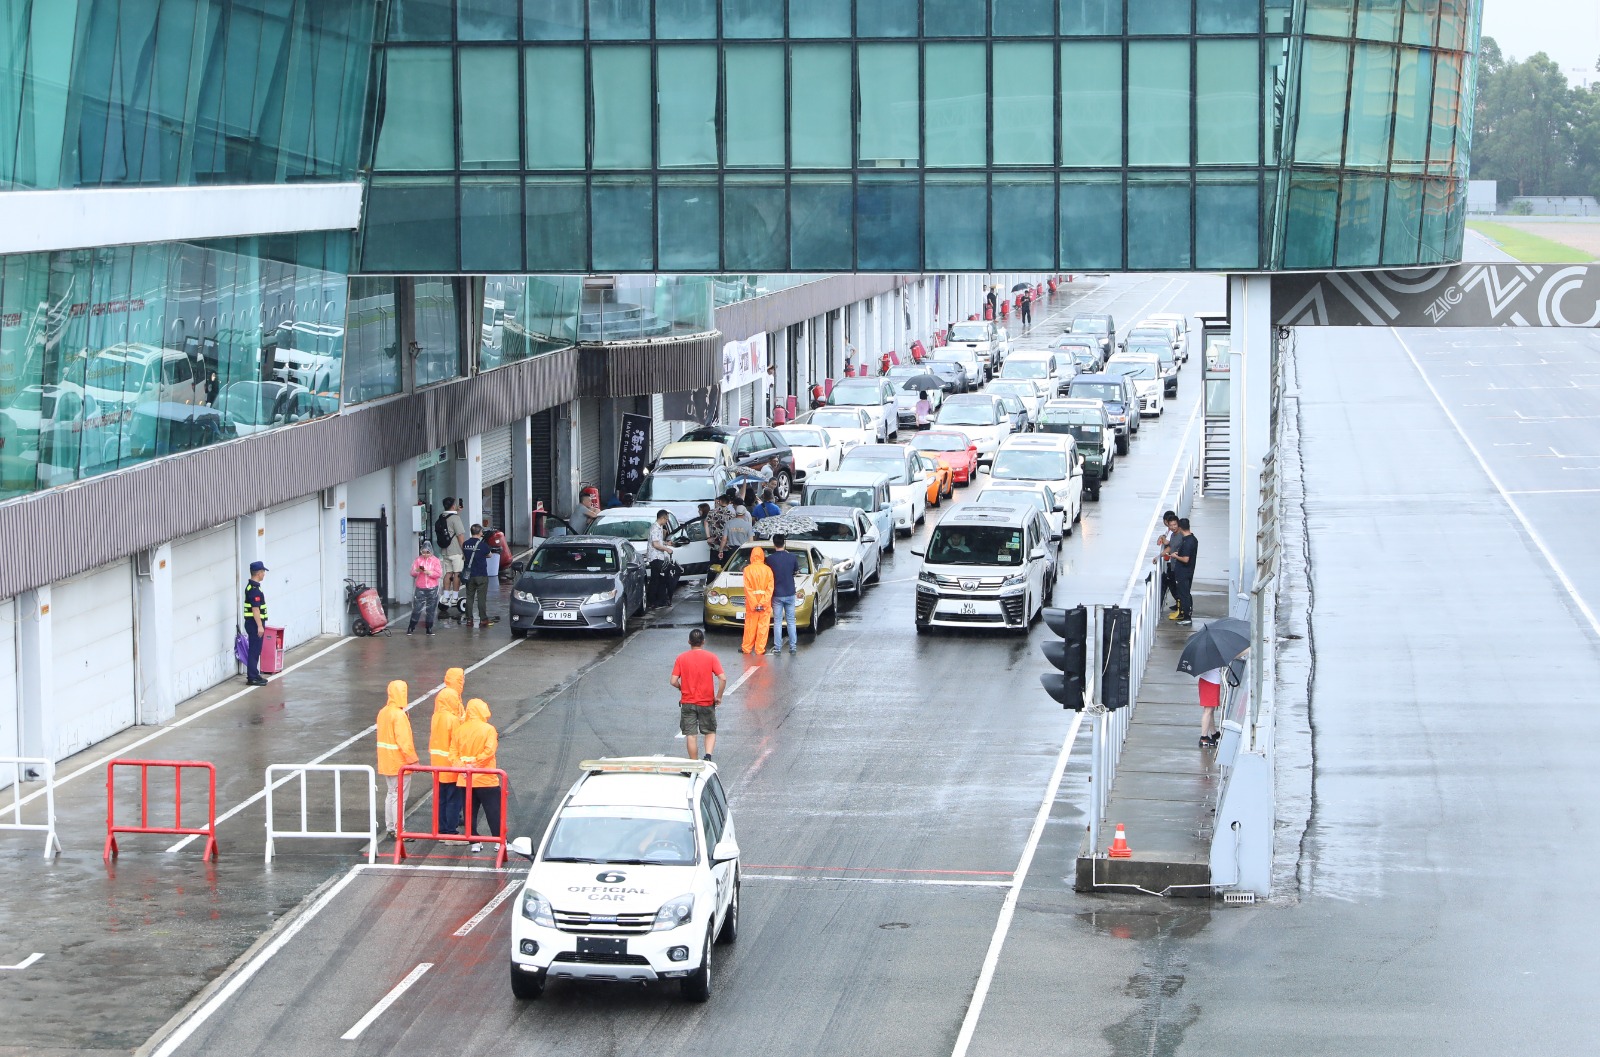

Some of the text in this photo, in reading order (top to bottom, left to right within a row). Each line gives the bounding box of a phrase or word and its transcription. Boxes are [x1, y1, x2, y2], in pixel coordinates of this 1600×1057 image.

[624, 421, 632, 438] HAVE
[595, 869, 627, 883] 6
[567, 886, 650, 895] OFFICIAL
[587, 893, 626, 901] CAR
